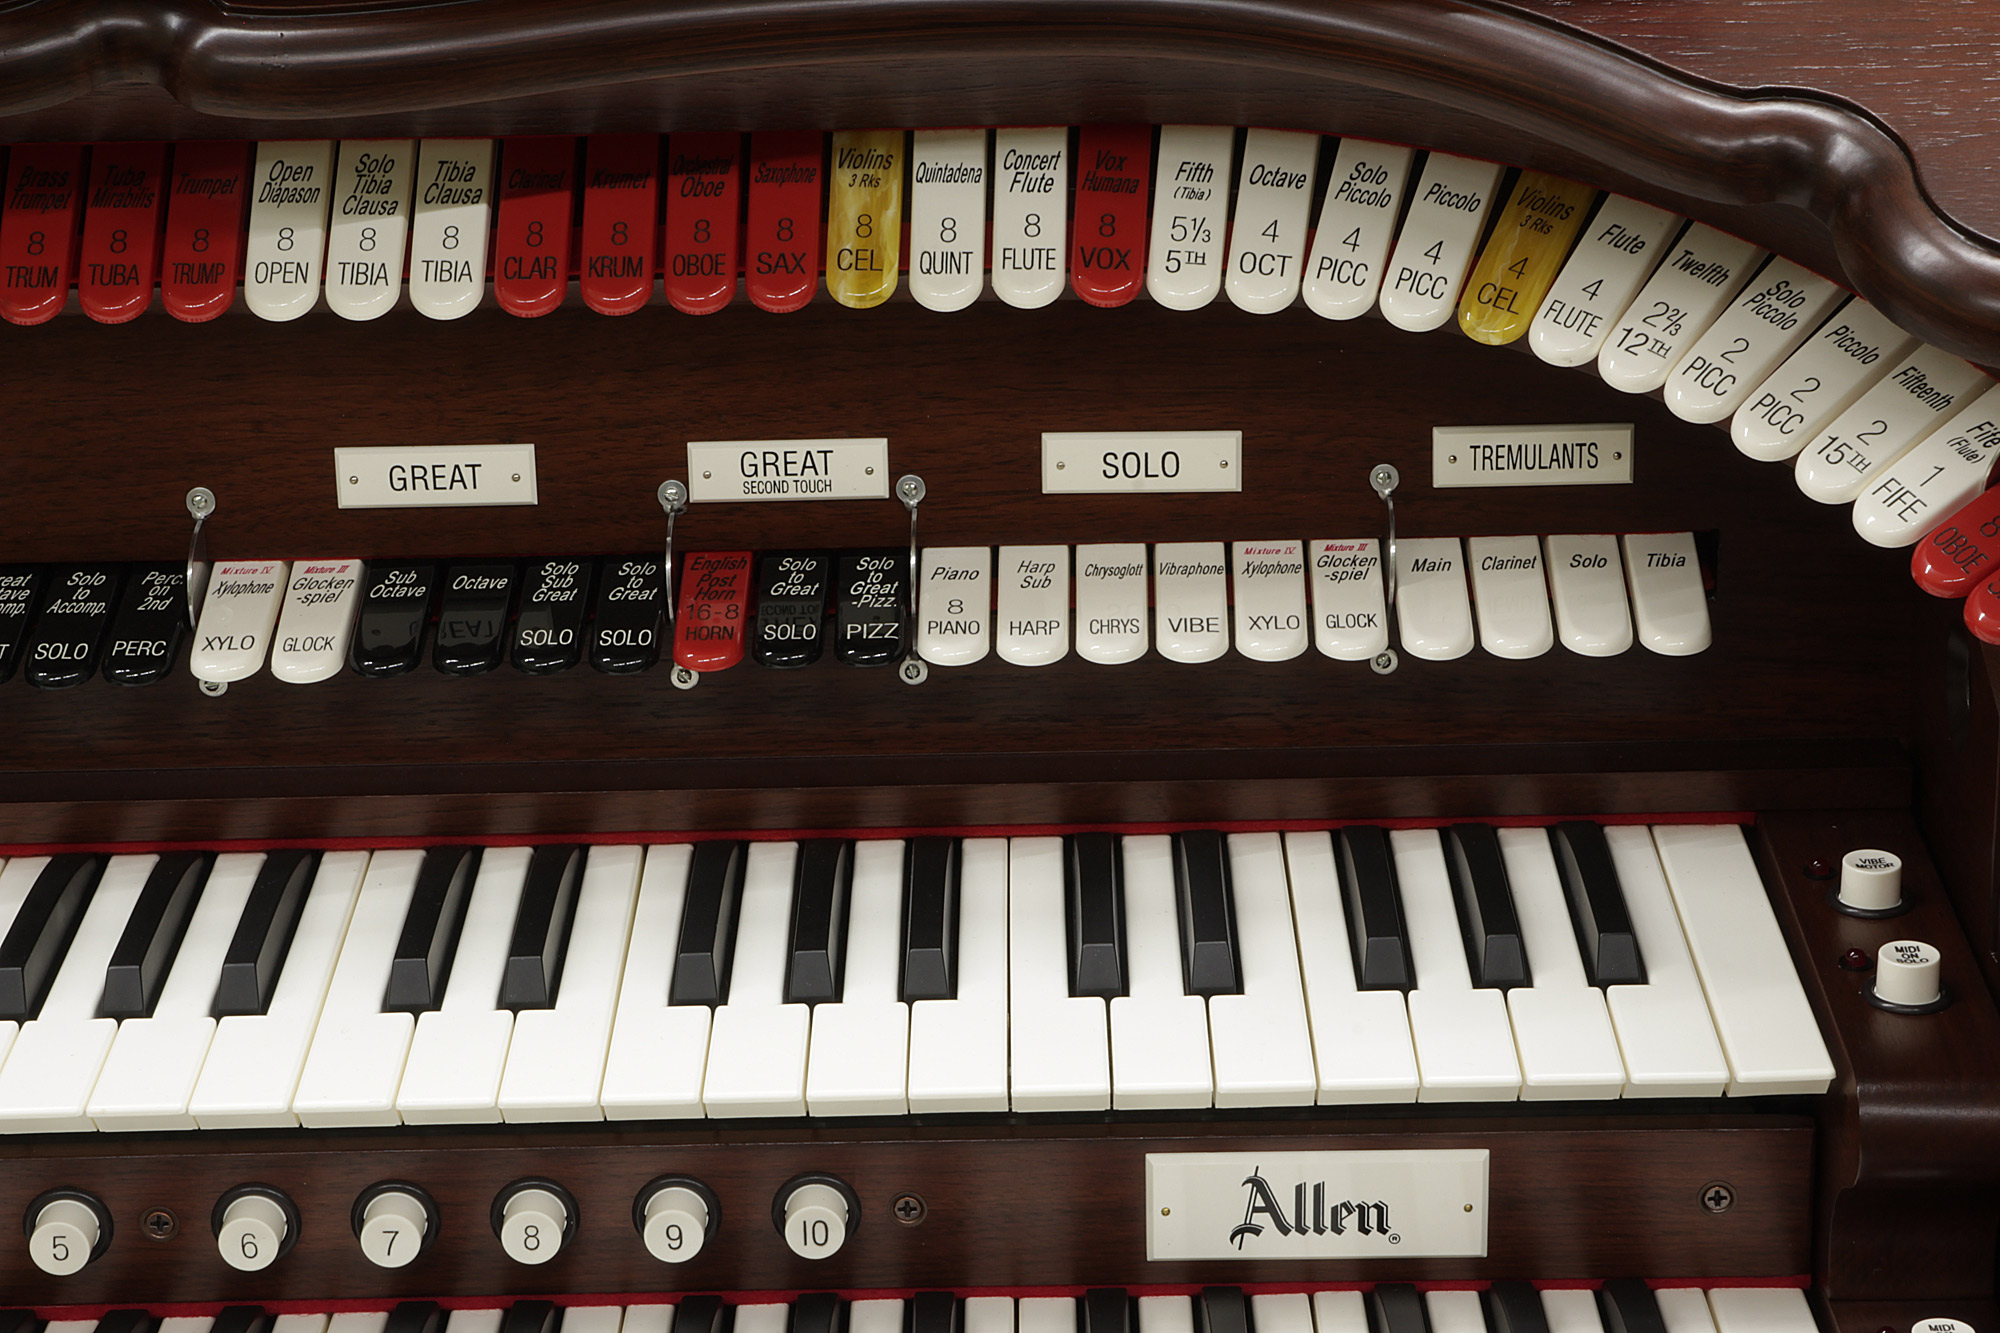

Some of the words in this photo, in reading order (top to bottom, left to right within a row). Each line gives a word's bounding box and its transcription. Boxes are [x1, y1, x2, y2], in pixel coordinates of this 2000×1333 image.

[355, 153, 395, 174] Solo
[837, 148, 893, 171] Violins
[1003, 149, 1061, 171] Concert
[269, 160, 313, 185] Open
[435, 161, 476, 182] Tibia
[754, 162, 817, 188] Saxophone
[849, 173, 857, 186] 3
[859, 174, 880, 188] Rks
[915, 162, 982, 184] Quintadena
[1175, 161, 1214, 183] Fifth
[1249, 164, 1307, 190] Octave
[1350, 161, 1388, 185] Solo
[352, 174, 392, 195] Tibia
[680, 177, 725, 197] Oboe
[1009, 172, 1054, 193] Flute
[258, 182, 320, 208] Diapason
[424, 183, 483, 204] Clausa
[1174, 186, 1211, 201] (Tibia)
[1334, 181, 1392, 208] Piccolo
[1423, 182, 1481, 213] Piccolo
[342, 195, 398, 215] Clausa
[694, 219, 711, 243] 8
[777, 218, 793, 241] 8
[856, 214, 872, 238] 8
[940, 217, 957, 242] 8
[1024, 213, 1041, 238] 8
[1099, 214, 1115, 237] 8
[1262, 219, 1279, 243] 4
[277, 227, 294, 251] 8
[359, 228, 376, 251] 8
[442, 226, 459, 249] 8
[1343, 227, 1360, 252] 4
[1598, 223, 1646, 255] Flute
[837, 248, 883, 271] CEL
[919, 251, 973, 275] QUINT
[1002, 248, 1056, 270] FLUTE
[1080, 247, 1131, 271] VOX
[1424, 240, 1443, 265] 4
[172, 263, 225, 284] TRUMP
[255, 261, 309, 284] OPEN
[338, 262, 389, 286] TIBIA
[422, 260, 472, 282] TIBIA
[504, 257, 557, 279] CLAR
[589, 256, 643, 278] KRUM
[673, 254, 726, 276] OBOE
[756, 252, 806, 275] SAX
[1239, 251, 1292, 277] OCT
[1317, 256, 1368, 287] PICC
[1508, 257, 1528, 280] 4
[1671, 249, 1730, 288] Twelfth
[6, 266, 58, 288] TRUM
[89, 264, 139, 286] TUBA
[1395, 267, 1447, 299] PICC
[1477, 282, 1520, 315] CEL
[1582, 279, 1604, 301] 4
[1766, 280, 1806, 308] Solo
[1543, 299, 1603, 338] FLUTE
[1742, 292, 1798, 331] Piccolo
[1721, 337, 1749, 364] 2
[1824, 324, 1880, 365] Piccolo
[1682, 355, 1737, 396] PICC
[1791, 377, 1821, 403] 2
[1892, 365, 1954, 412] Fifteenth
[1750, 393, 1804, 435] PICC
[1857, 420, 1888, 446] 2
[1469, 442, 1599, 472] TREMULANTS
[1947, 436, 1986, 464] (Flute)
[740, 450, 834, 477] GREAT
[1101, 451, 1181, 479] SOLO
[388, 463, 482, 492] GREAT
[742, 480, 789, 495] SECOND
[793, 478, 832, 493] TOUCH
[1920, 465, 1945, 487] 1
[1872, 477, 1928, 522] FIFE
[1324, 544, 1355, 552] Mixture
[1933, 526, 1989, 574] OBOE
[220, 567, 258, 575] Mixture
[304, 566, 336, 575] Mixture
[541, 562, 579, 576] Solo
[618, 562, 656, 576] Solo
[690, 556, 747, 572] English
[778, 557, 817, 572] Solo
[856, 556, 894, 571] Solo
[1017, 560, 1056, 575] Harp
[1159, 562, 1225, 578] Vibraphone
[1242, 561, 1302, 578] Xylophone
[1316, 555, 1377, 569] Glocken
[1411, 558, 1452, 572] Main
[1481, 556, 1537, 571] Clarinet
[1569, 554, 1607, 569] Solo
[1646, 553, 1686, 568] Tibia
[67, 572, 106, 586] Solo
[141, 572, 183, 585] Perc.
[385, 570, 417, 585] Sub
[541, 575, 574, 589] Sub
[627, 575, 643, 589] to
[697, 572, 737, 588] Post
[788, 571, 805, 584] to
[867, 570, 883, 583] to
[930, 567, 980, 581] Piano
[1020, 575, 1052, 589] Sub
[1084, 563, 1143, 580] Chrysoglott
[1324, 568, 1370, 584] -spiel
[149, 586, 171, 597] on
[212, 581, 274, 597] Xylophone
[292, 577, 355, 591] Glocken
[370, 585, 426, 599] Octave
[452, 575, 508, 590] Octave
[770, 582, 819, 596] Great
[850, 580, 898, 595] Great
[72, 587, 90, 600] to
[137, 597, 173, 611] 2nd
[297, 590, 344, 606] -spiel
[532, 587, 578, 602] Great
[608, 587, 658, 601] Great
[851, 595, 897, 608] -Pizz.
[47, 599, 107, 617] Accomp.
[686, 604, 739, 621] 16-8
[948, 599, 963, 614] 8
[846, 623, 899, 640] PIZZ
[928, 621, 980, 635] PIANO
[1010, 620, 1060, 636] HARP
[1089, 618, 1140, 634] CHRYS
[1168, 618, 1219, 633] VIBE
[1249, 615, 1300, 631] XYLO
[1326, 613, 1377, 629] GLOCK
[202, 635, 255, 650] XYLO
[520, 629, 573, 646] SOLO
[600, 629, 652, 646] SOLO
[686, 626, 734, 641] HORN
[764, 624, 816, 641] SOLO
[35, 643, 89, 660] SOLO
[112, 641, 167, 656] PERC
[283, 636, 336, 652] GLOCK
[1229, 1165, 1391, 1250] Allen
[382, 1230, 399, 1256] 7
[524, 1225, 540, 1250] 8
[666, 1225, 683, 1250] 9
[802, 1220, 829, 1246] 10
[52, 1235, 69, 1261] 5
[241, 1233, 258, 1259] 6
